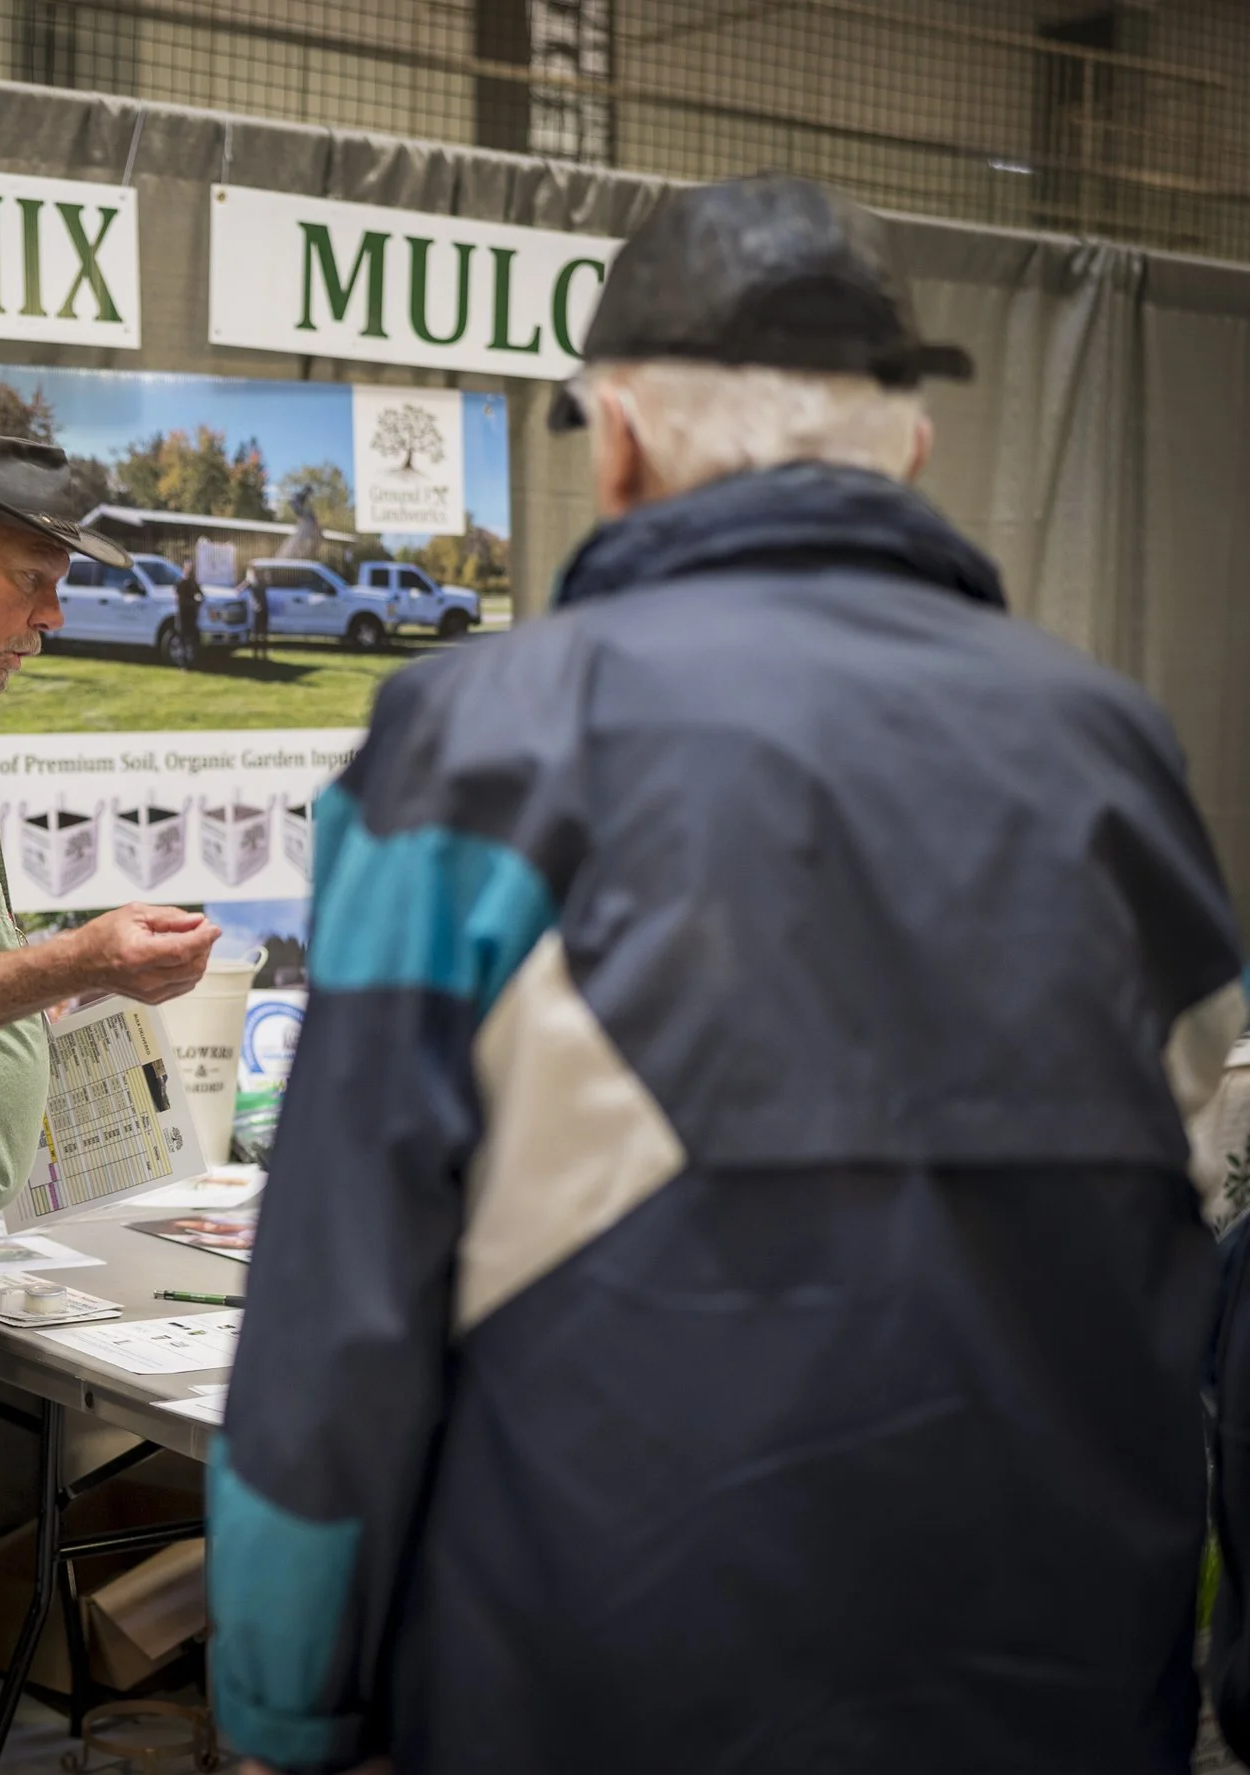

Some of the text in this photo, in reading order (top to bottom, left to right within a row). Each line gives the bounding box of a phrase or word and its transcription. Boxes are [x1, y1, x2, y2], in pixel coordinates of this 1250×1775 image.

[296, 221, 606, 360] MULC
[24, 754, 116, 774] Premium
[164, 750, 235, 776] Organic
[241, 747, 305, 770] Garden
